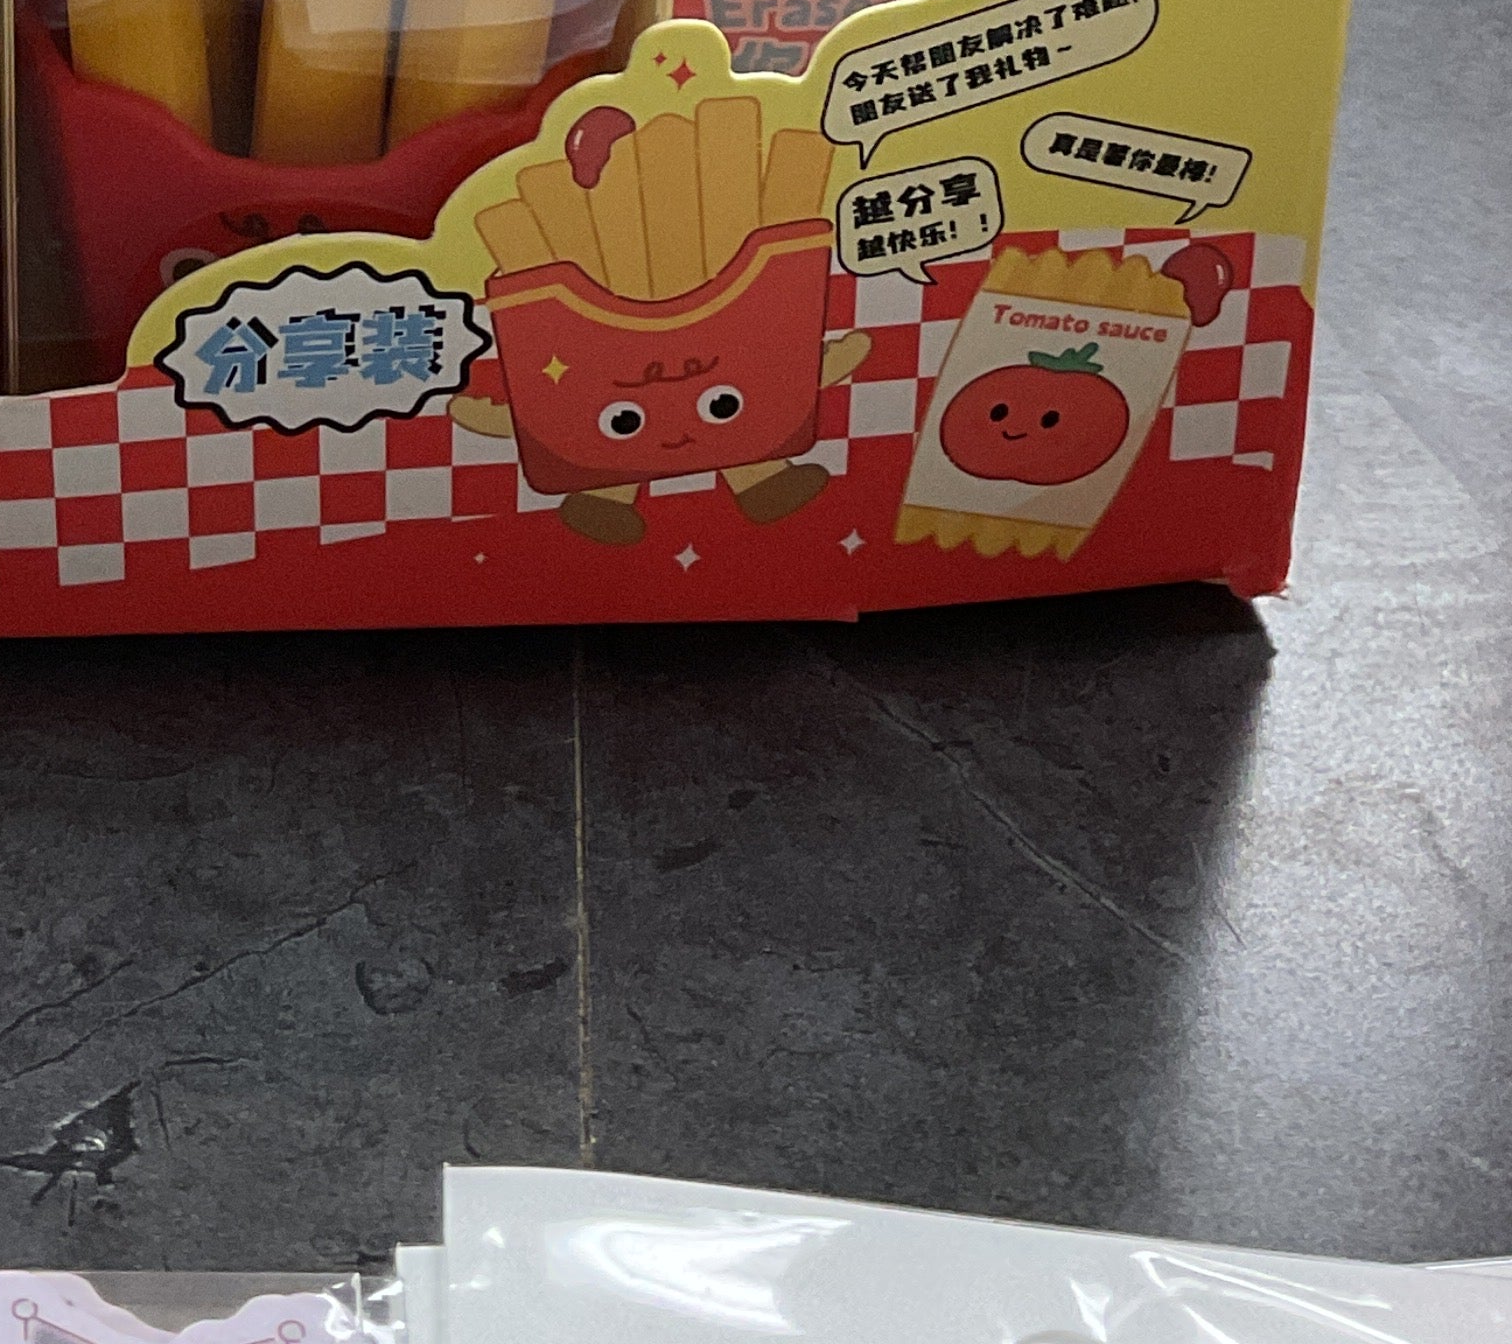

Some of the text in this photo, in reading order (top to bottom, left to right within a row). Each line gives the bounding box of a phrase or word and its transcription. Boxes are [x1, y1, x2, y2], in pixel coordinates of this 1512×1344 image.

[852, 173, 981, 229] 越分享
[195, 305, 446, 394] 分享装
[994, 304, 1168, 343] Tomato sauce
